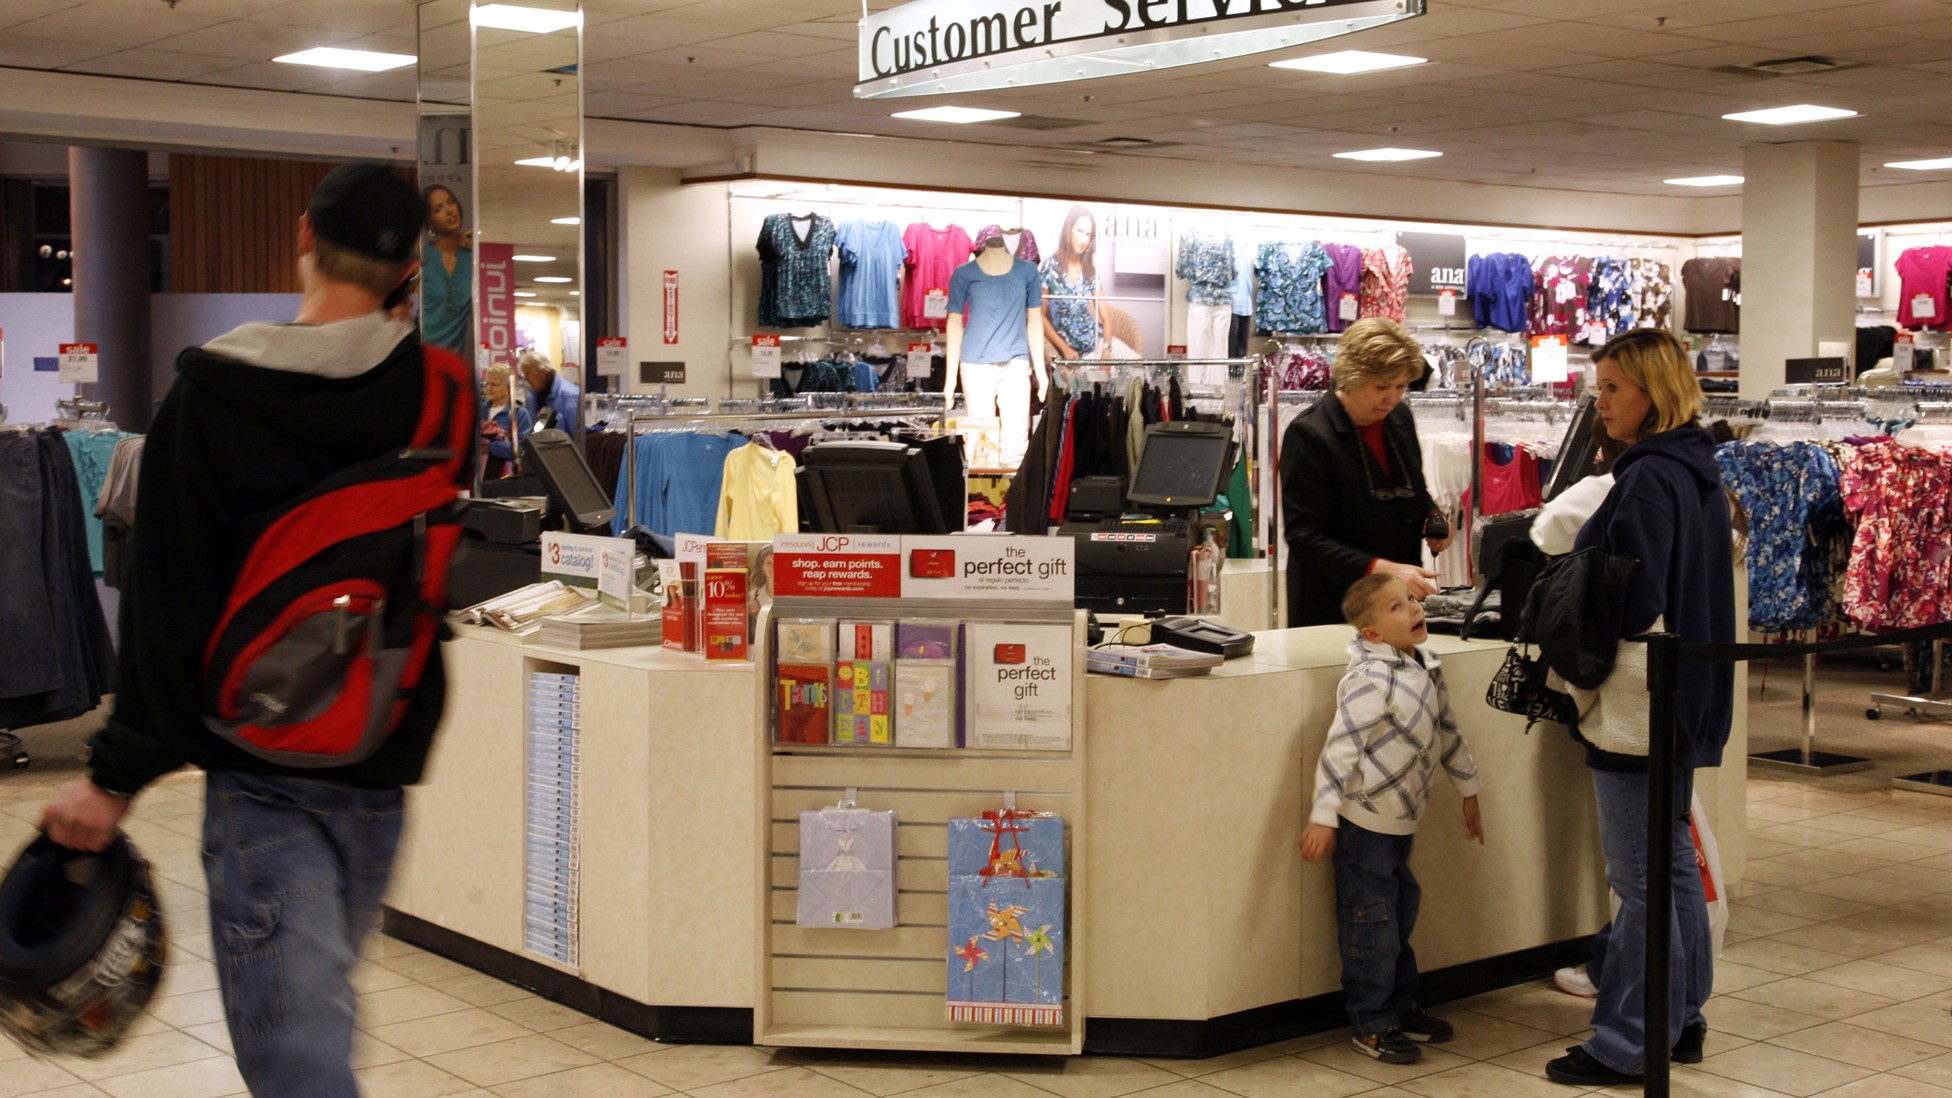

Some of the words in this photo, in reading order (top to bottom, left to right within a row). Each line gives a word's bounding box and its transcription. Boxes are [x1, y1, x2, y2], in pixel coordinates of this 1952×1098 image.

[871, 1, 1062, 78] Customer
[602, 337, 622, 348] sale
[757, 335, 776, 346] sale
[66, 344, 90, 354] sale
[817, 536, 850, 552] JCP
[1005, 546, 1026, 558] the
[560, 553, 594, 571] catalog!
[792, 558, 821, 569] shop.
[823, 560, 846, 568] earn
[848, 559, 883, 571] points.
[964, 558, 1033, 578] perfect
[1038, 558, 1067, 579] gift
[803, 570, 826, 580] reap
[828, 569, 873, 579] rewards.
[707, 580, 736, 598] 10%
[1033, 656, 1051, 666] the
[998, 666, 1056, 683] perfect
[1014, 683, 1039, 701] gift
